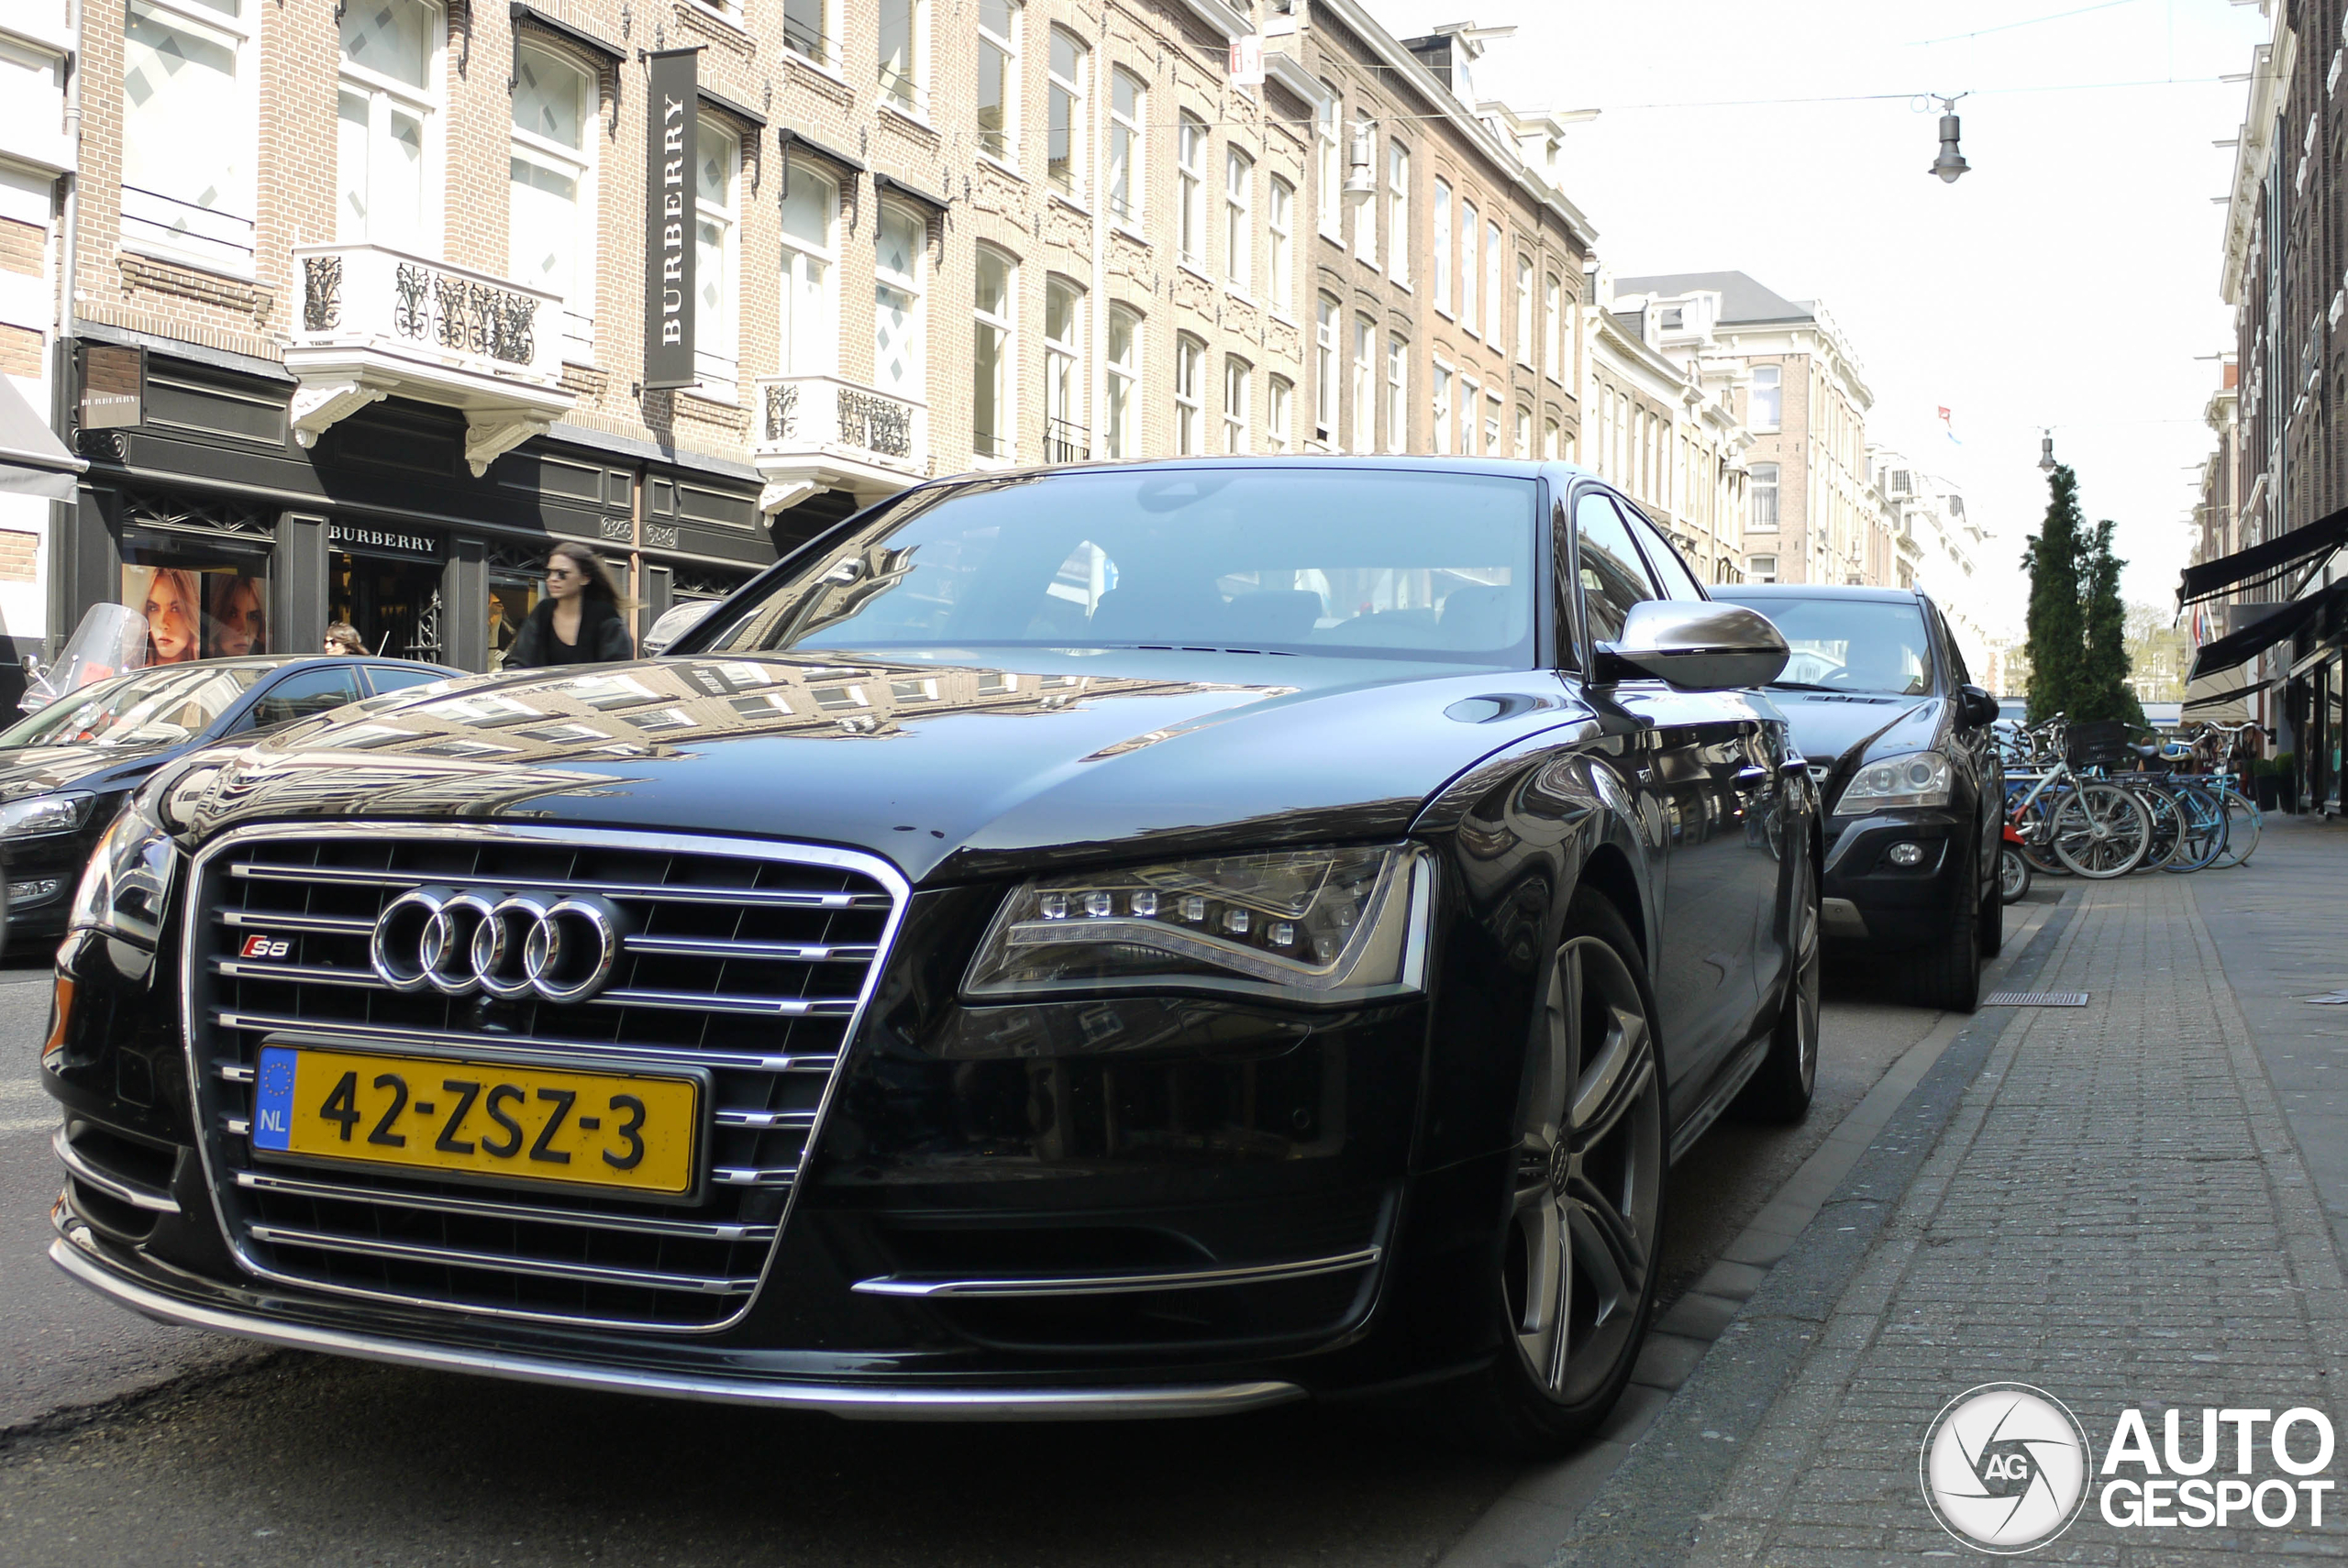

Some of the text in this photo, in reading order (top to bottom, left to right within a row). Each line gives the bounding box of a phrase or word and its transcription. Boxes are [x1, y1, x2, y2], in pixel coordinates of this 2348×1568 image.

[662, 94, 683, 347] BURBERRY
[328, 525, 436, 552] BURBERRY
[250, 940, 290, 956] S8
[260, 1109, 286, 1133] NL
[319, 1070, 647, 1170] 42-ZSZ-3
